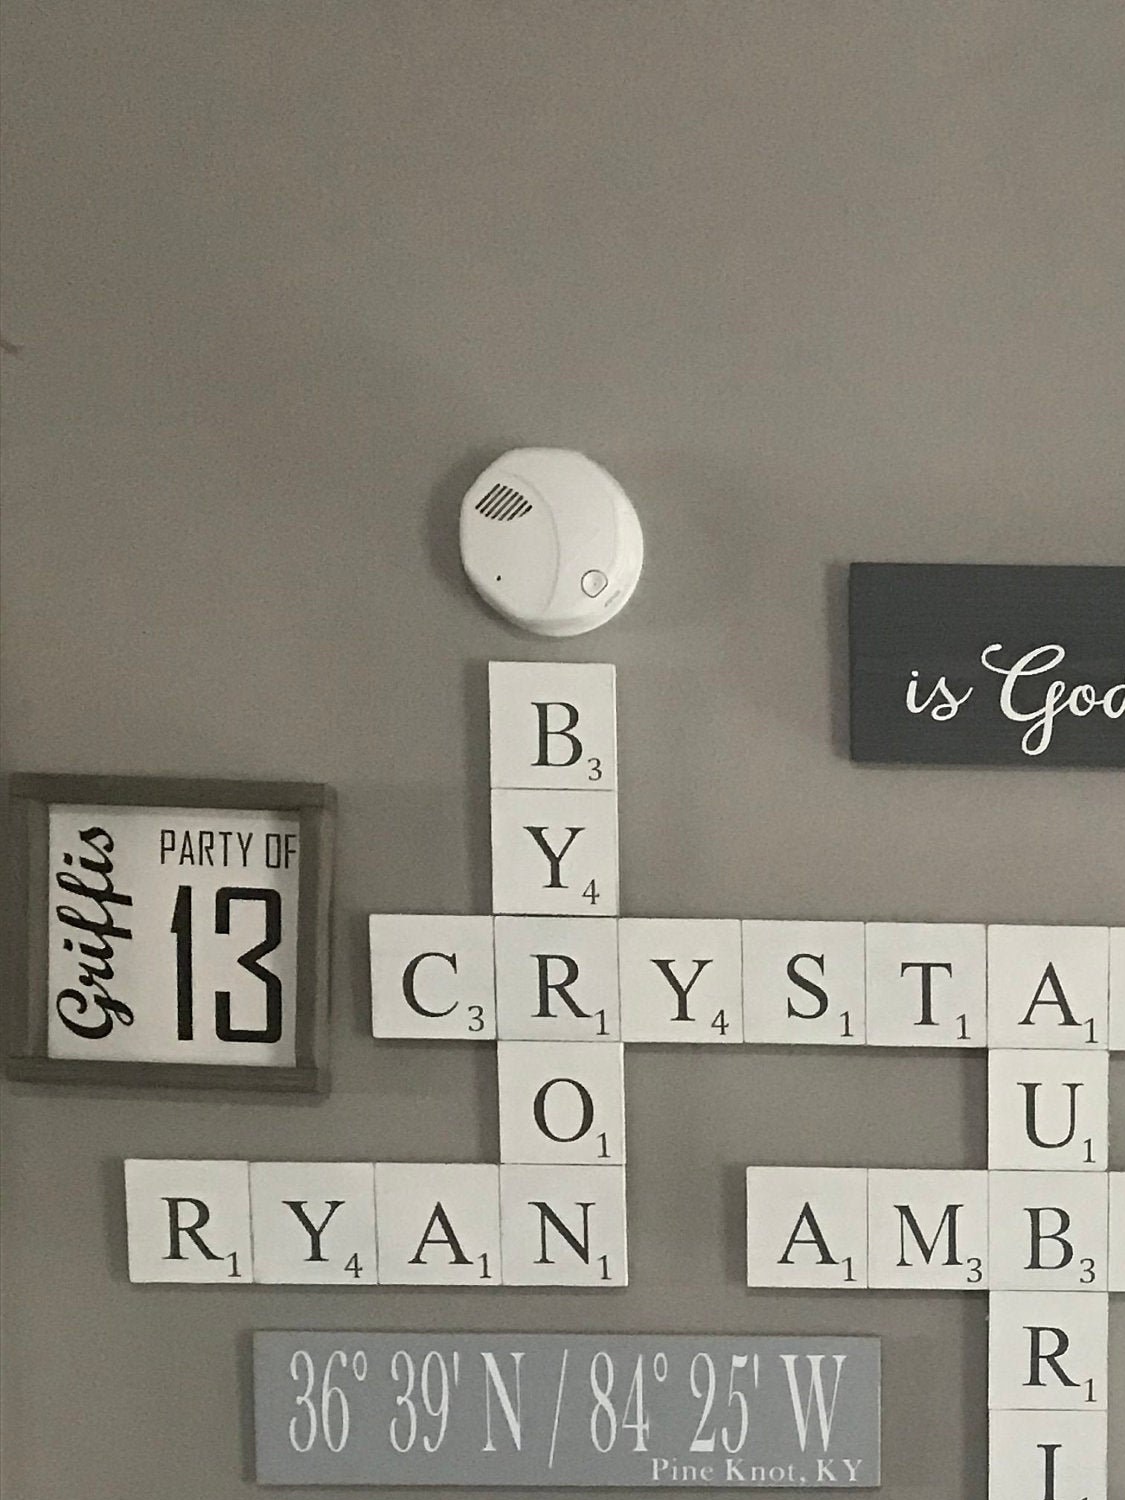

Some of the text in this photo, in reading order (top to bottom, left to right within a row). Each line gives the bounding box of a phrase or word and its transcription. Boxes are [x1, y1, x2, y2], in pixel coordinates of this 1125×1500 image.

[905, 670, 973, 721] is
[160, 829, 297, 869] PARTY OF
[56, 827, 134, 1039] Griffis
[170, 885, 282, 1043] 13
[581, 757, 612, 1159] 3 4 1
[522, 701, 597, 1265] BYRON
[467, 1005, 485, 1032] 3
[594, 1008, 610, 1036] 1
[711, 1009, 730, 1036] 4
[839, 1010, 854, 1037] 1
[956, 1013, 971, 1040] 1
[1083, 1017, 1099, 1044] 1
[1083, 1138, 1096, 1164] 1
[160, 1196, 597, 1265] RYAN
[227, 1251, 612, 1280] 1 4 1 1
[841, 1256, 856, 1282] 1
[966, 1257, 983, 1283] 3
[1079, 1257, 1096, 1284] 3
[289, 1349, 847, 1469] 36° 39' N / 84° 25' W
[1085, 1378, 1097, 1403] 1
[651, 1458, 864, 1485] Pine Knot, KY
